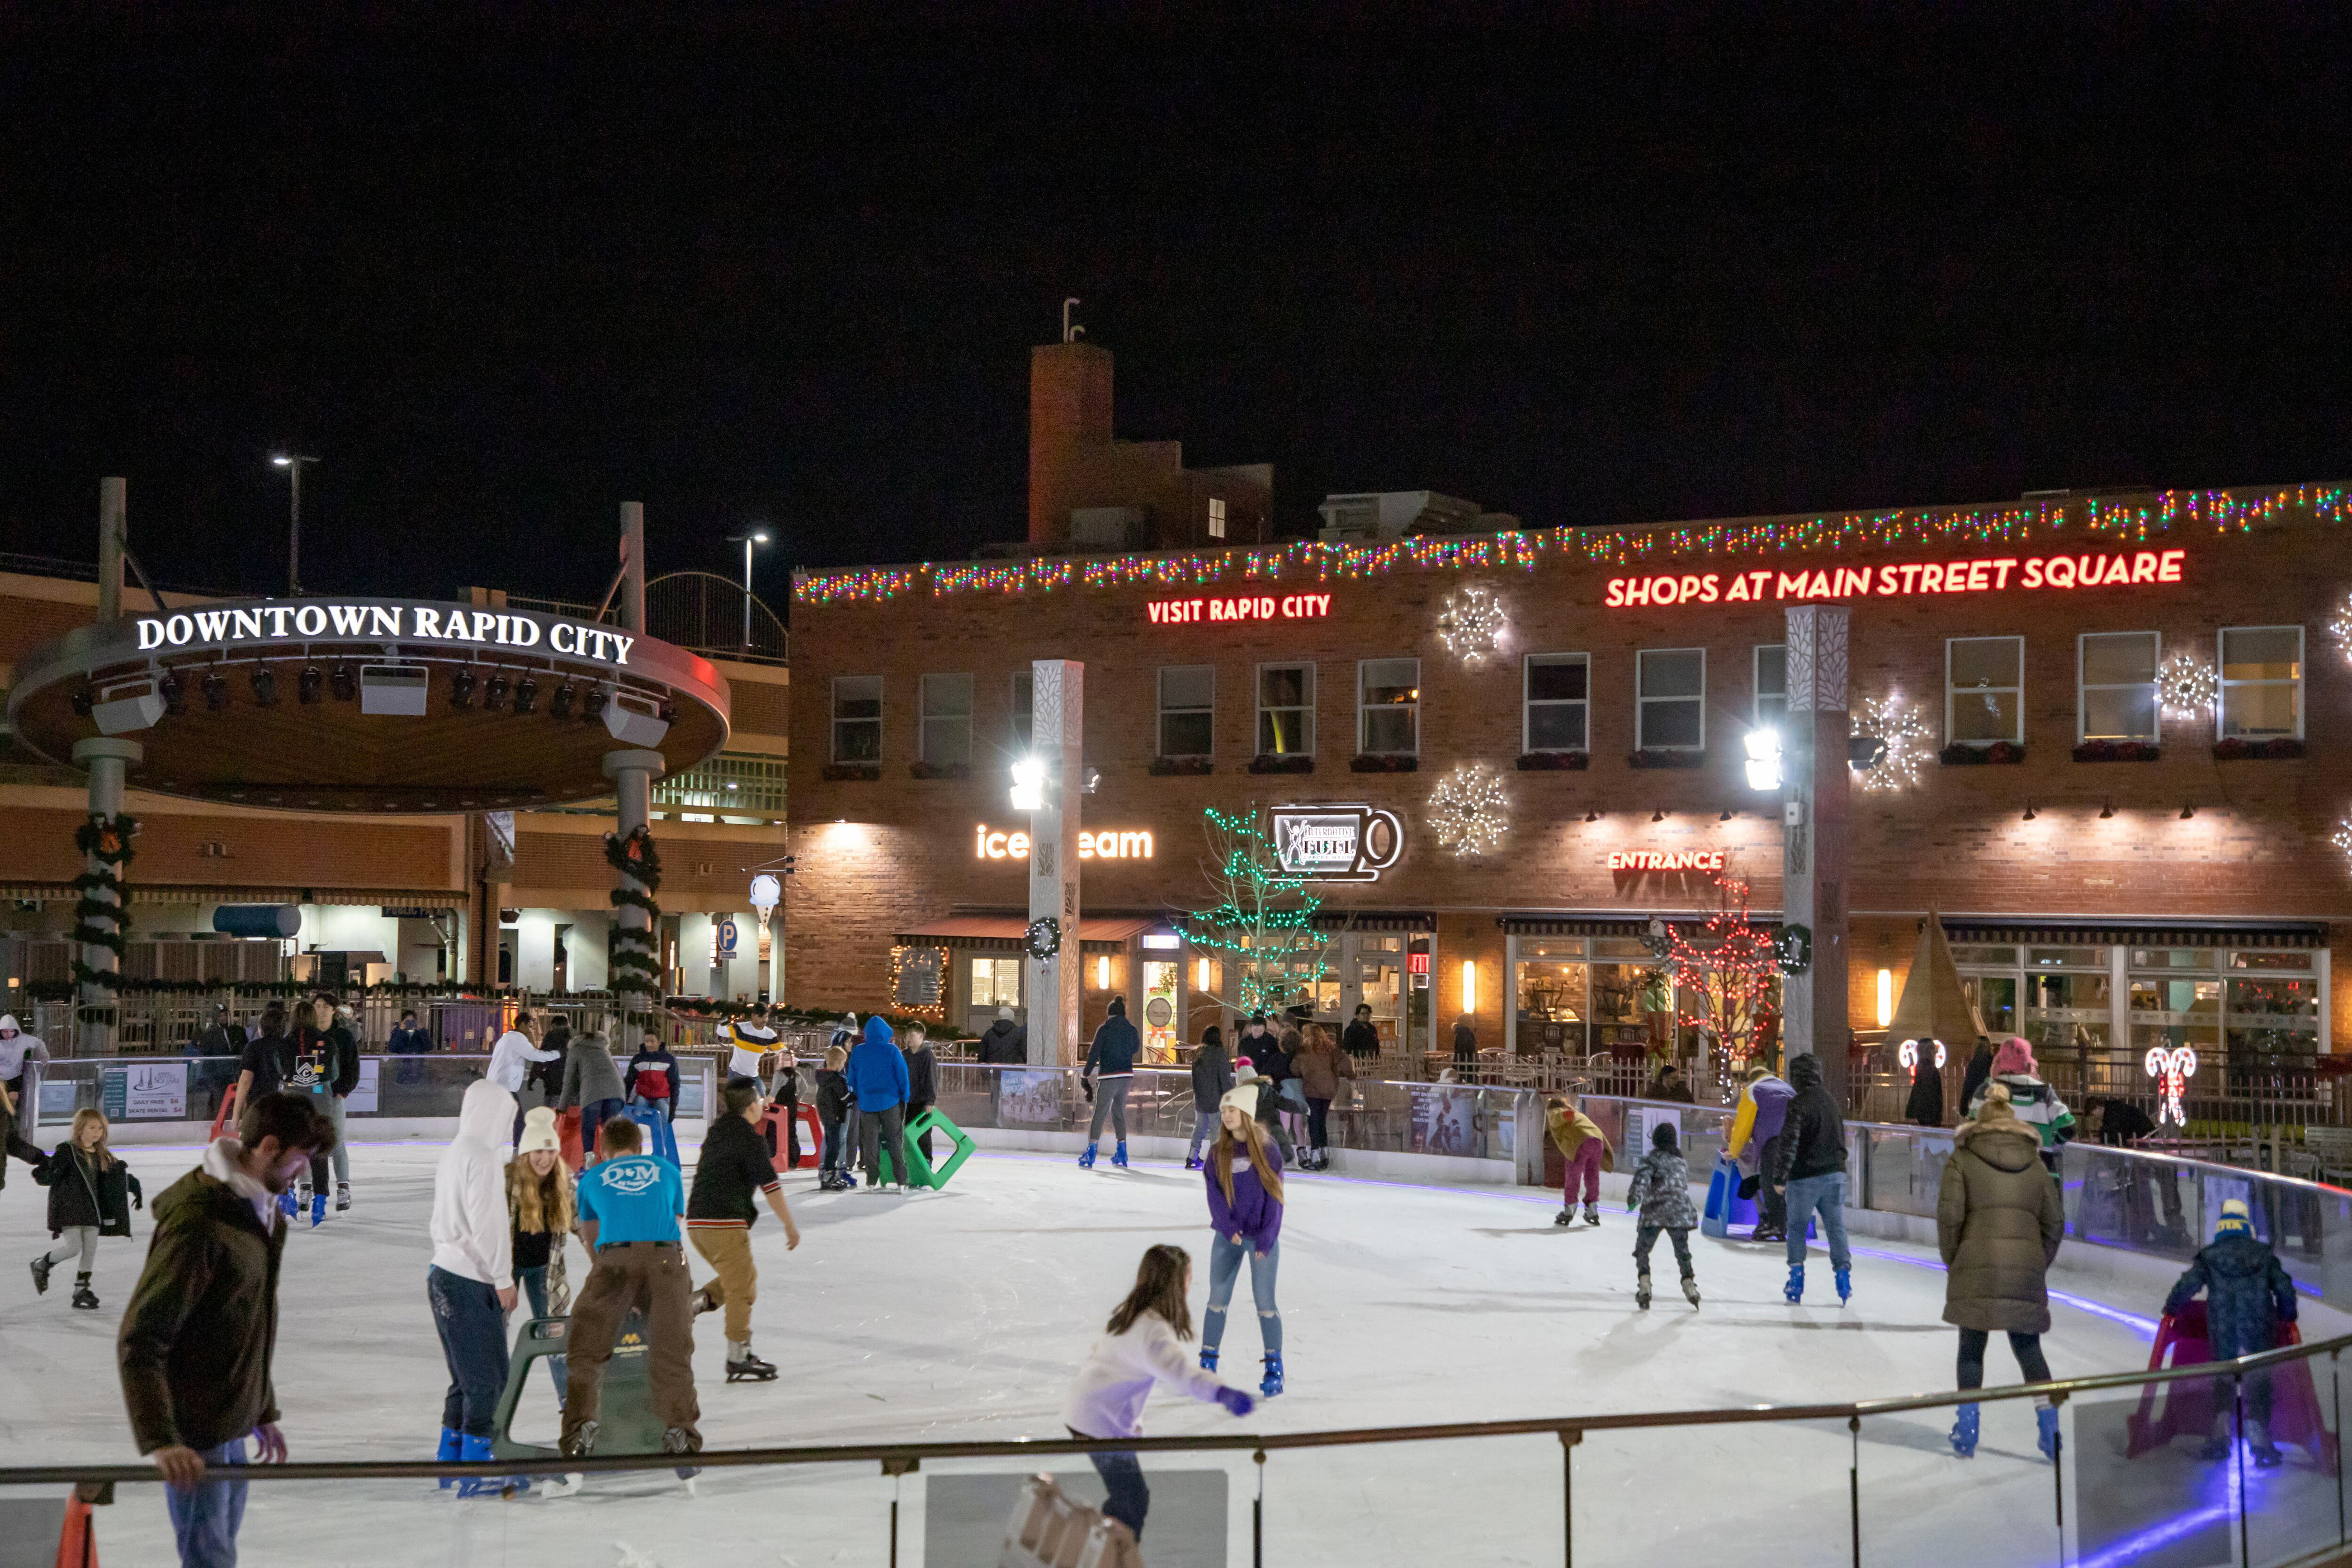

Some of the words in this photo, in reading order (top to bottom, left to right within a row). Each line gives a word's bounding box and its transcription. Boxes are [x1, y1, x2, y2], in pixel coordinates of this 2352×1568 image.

[1604, 573, 1720, 607] SHOPS
[1724, 570, 1773, 602] AT
[1775, 566, 1873, 600] MAIN
[1876, 558, 2018, 596] STREET
[2020, 549, 2186, 590] SQUARE
[1147, 599, 1204, 624] VISIT
[1209, 597, 1276, 621] RAPID
[1281, 594, 1331, 618] CITY
[136, 606, 403, 650] DOWNTOWN
[413, 607, 540, 646] RAPID
[550, 623, 634, 664] CITY
[977, 824, 1031, 859] ice
[1078, 831, 1153, 859] eam
[1303, 839, 1356, 854] FUEL
[1607, 851, 1725, 870] ENTRANCE
[723, 924, 734, 947] P
